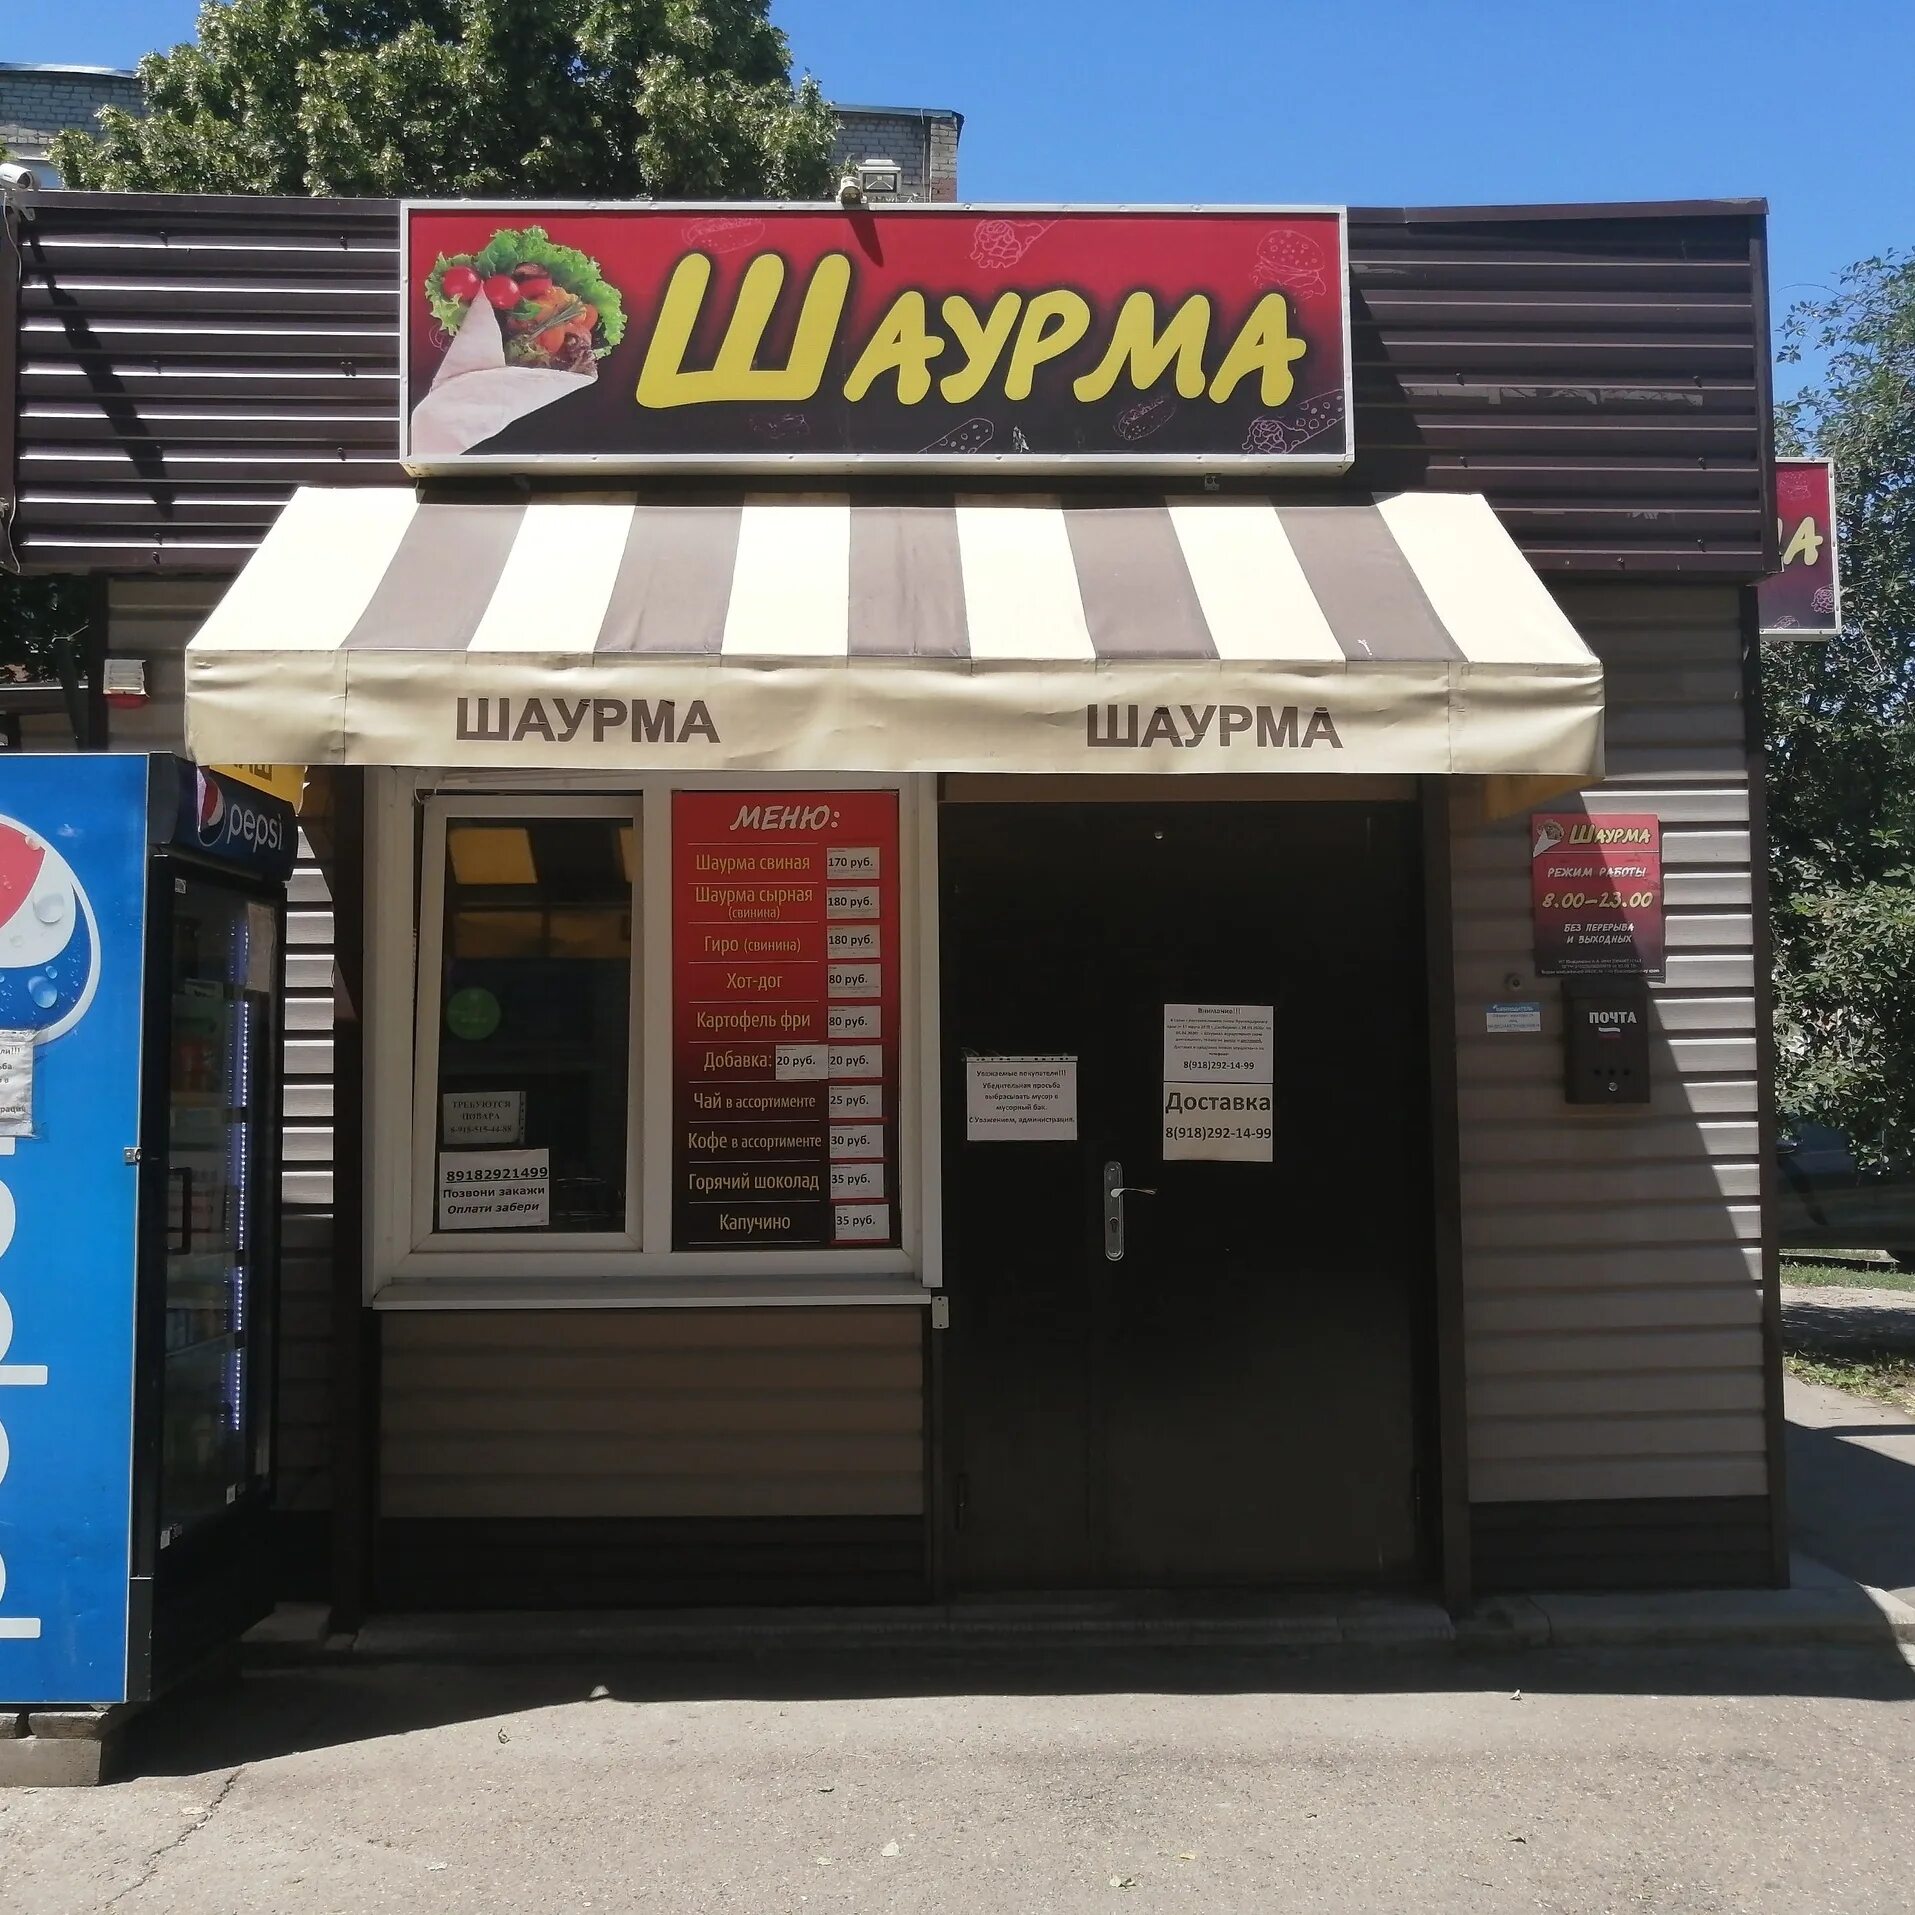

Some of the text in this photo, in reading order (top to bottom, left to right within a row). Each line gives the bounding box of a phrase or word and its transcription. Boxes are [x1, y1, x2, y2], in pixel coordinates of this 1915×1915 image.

[636, 253, 1306, 408] ШАУРМА
[1778, 516, 1824, 566] А
[456, 697, 721, 743] ШАУРМА
[1087, 704, 1344, 749] ШАУРМА
[729, 804, 841, 831] МЕНЮ:
[226, 803, 283, 853] pepsi
[1568, 824, 1651, 845] ШАУРМА
[696, 854, 810, 874] Шаурма свиная
[828, 856, 874, 870] 170 руб.
[1547, 866, 1647, 878] РЕЖИМ РАБОТЫ
[695, 887, 813, 905] Шаурма сырная
[828, 895, 873, 908] 180 руб.
[728, 906, 780, 920] (свинина)
[1564, 922, 1635, 933] БЕЗ ПЕРЕРЫВА
[704, 935, 801, 956] Гиро (свинина)
[828, 934, 874, 947] 180 руб.
[1566, 934, 1632, 945] И ВЫХОДНЫХ
[726, 972, 783, 991] Хот-дог
[829, 973, 868, 986] 80 руб.
[697, 1010, 811, 1032] Картофель фри
[829, 1015, 868, 1028] 80 руб.
[1588, 1011, 1637, 1024] ПОЧТА
[704, 1050, 773, 1071] Добавка:
[776, 1055, 816, 1068] 20 руб.
[830, 1055, 869, 1068] 20 руб.
[1183, 1060, 1255, 1070] 8(918)292-14-99
[983, 1081, 1060, 1090] Убедительная просьба
[694, 1092, 816, 1111] Чай в ассортименте
[830, 1094, 869, 1107] 25 руб.
[996, 1103, 1031, 1111] мусорный
[1165, 1092, 1271, 1114] Доставка
[831, 1134, 870, 1147] 30 руб.
[1165, 1126, 1272, 1141] 8(918)292-14-99
[688, 1131, 822, 1152] Кофе в ассортименте
[446, 1166, 548, 1182] 89182921499
[831, 1173, 871, 1186] 35 руб.
[688, 1172, 820, 1194] Горячий шоколад
[443, 1186, 545, 1198] Позвони закажи
[447, 1202, 540, 1215] Оплати забери
[720, 1214, 791, 1234] Капучино
[836, 1214, 876, 1227] 35 руб.
